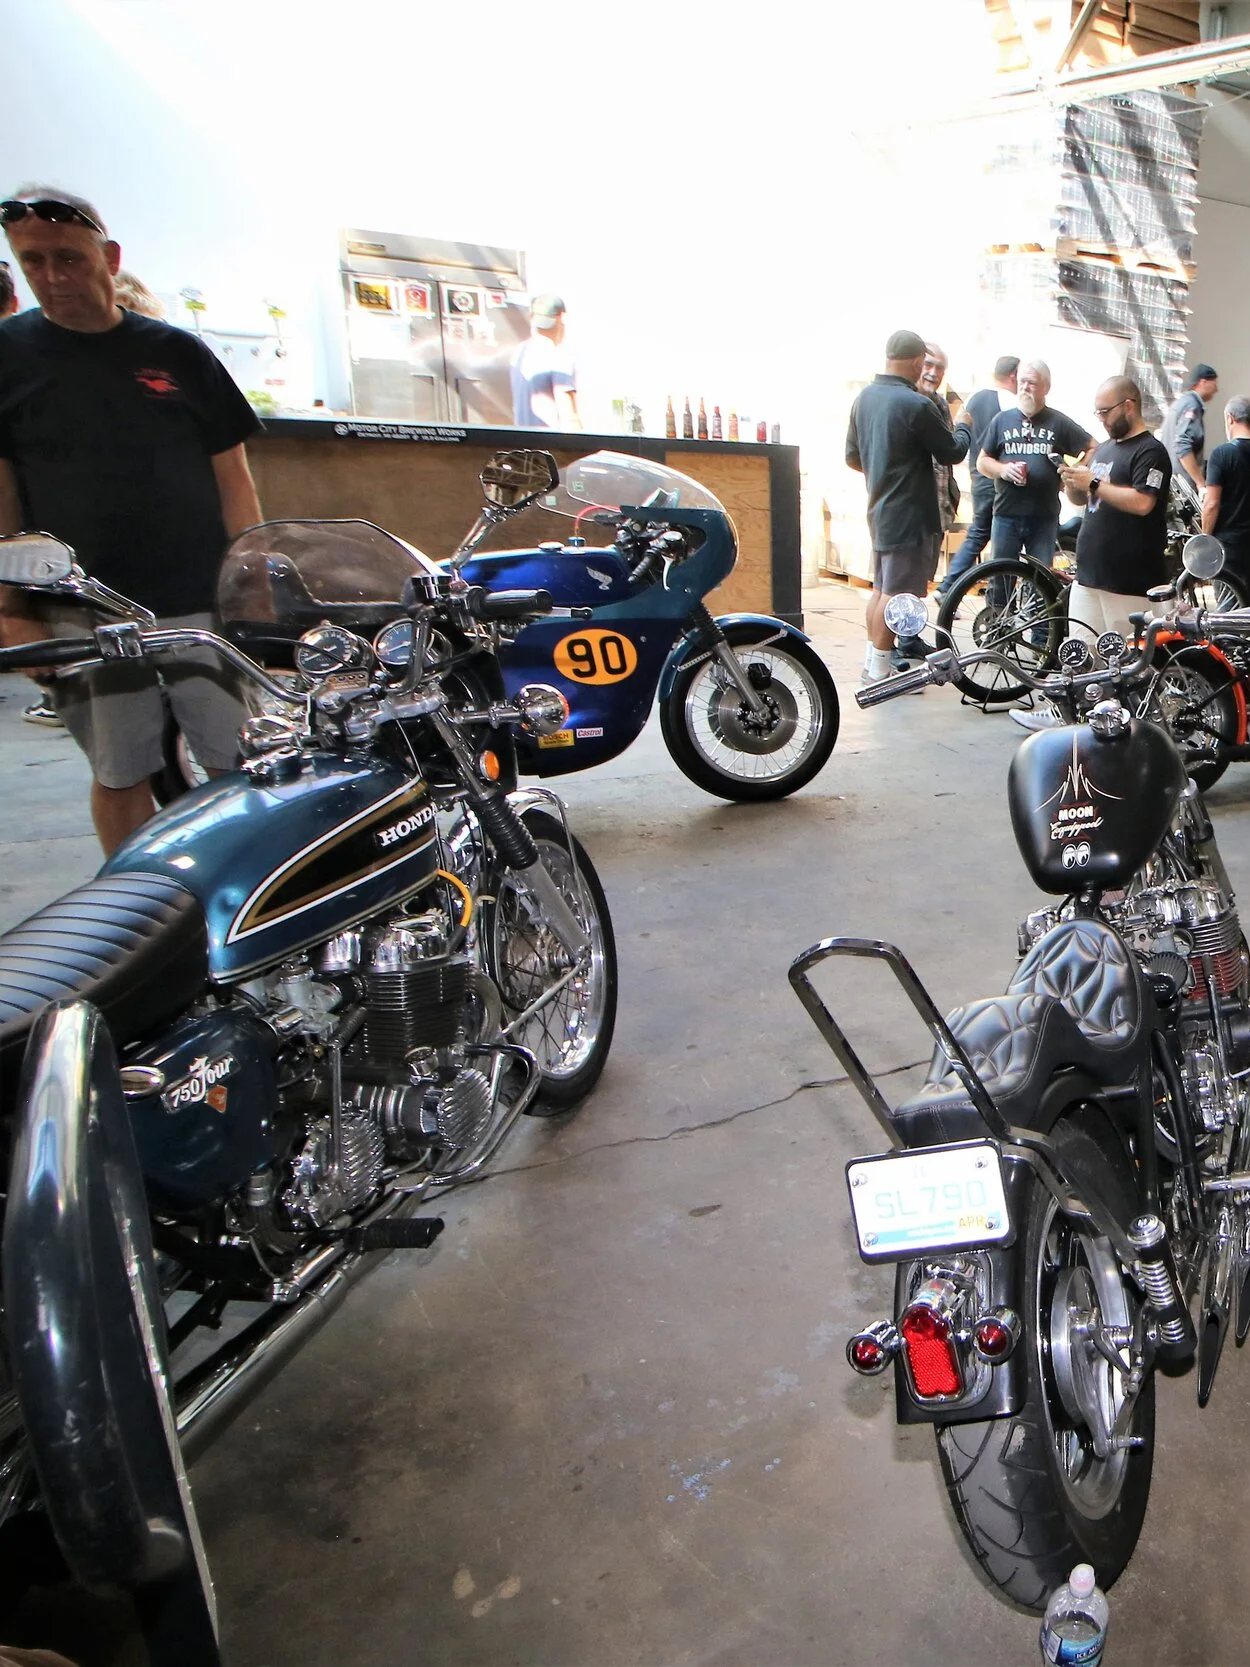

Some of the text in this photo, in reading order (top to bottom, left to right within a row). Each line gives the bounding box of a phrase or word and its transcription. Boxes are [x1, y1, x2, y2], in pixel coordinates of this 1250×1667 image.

[347, 422, 379, 433] MOTOR
[378, 424, 398, 434] CITY
[436, 427, 467, 437] WORKS
[1004, 442, 1053, 455] DAVIDSON
[567, 635, 628, 679] 90
[578, 729, 602, 737] Castrol
[1058, 805, 1094, 821] MOON
[1050, 816, 1104, 840] Equipped
[170, 1078, 200, 1108] 750
[958, 1214, 985, 1230] APR
